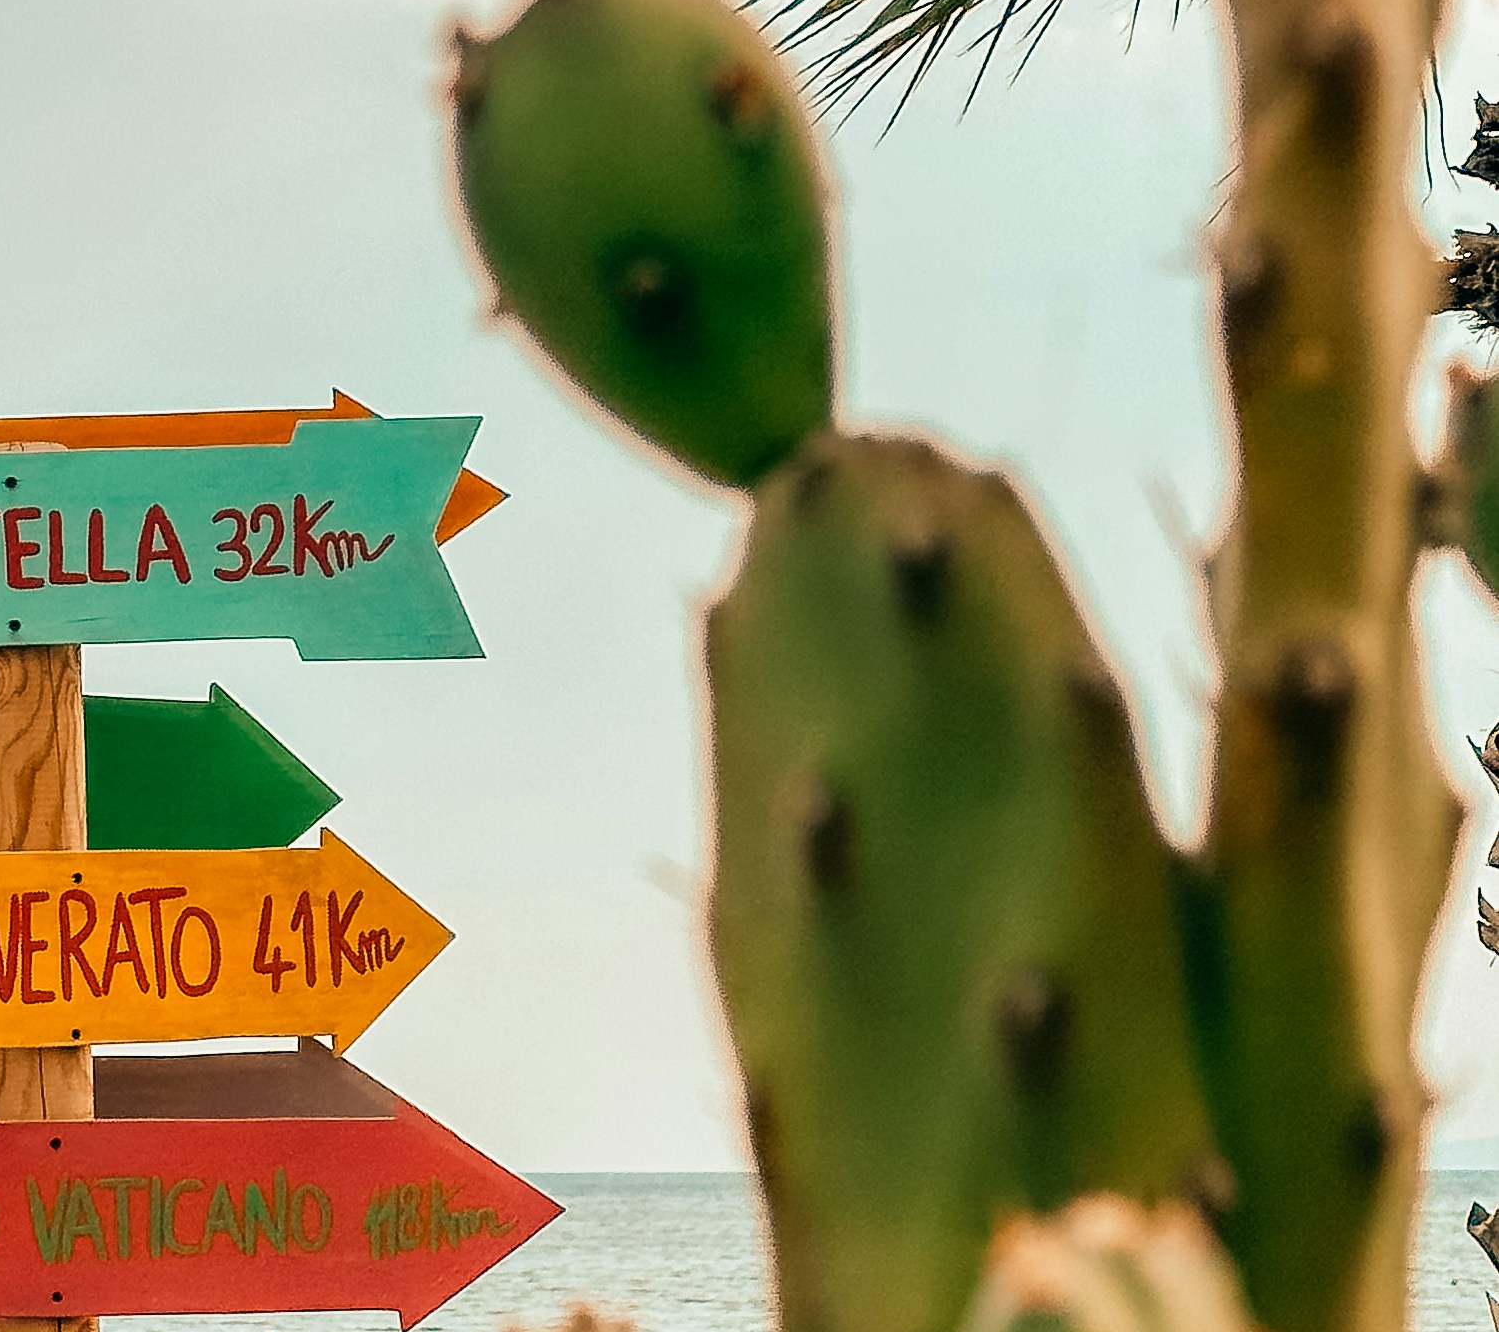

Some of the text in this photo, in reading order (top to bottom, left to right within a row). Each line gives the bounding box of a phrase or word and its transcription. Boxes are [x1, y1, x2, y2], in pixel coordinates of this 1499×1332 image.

[213, 494, 395, 582] 32Km
[252, 889, 405, 993] 41Km
[28, 1167, 332, 1265] VATICANO
